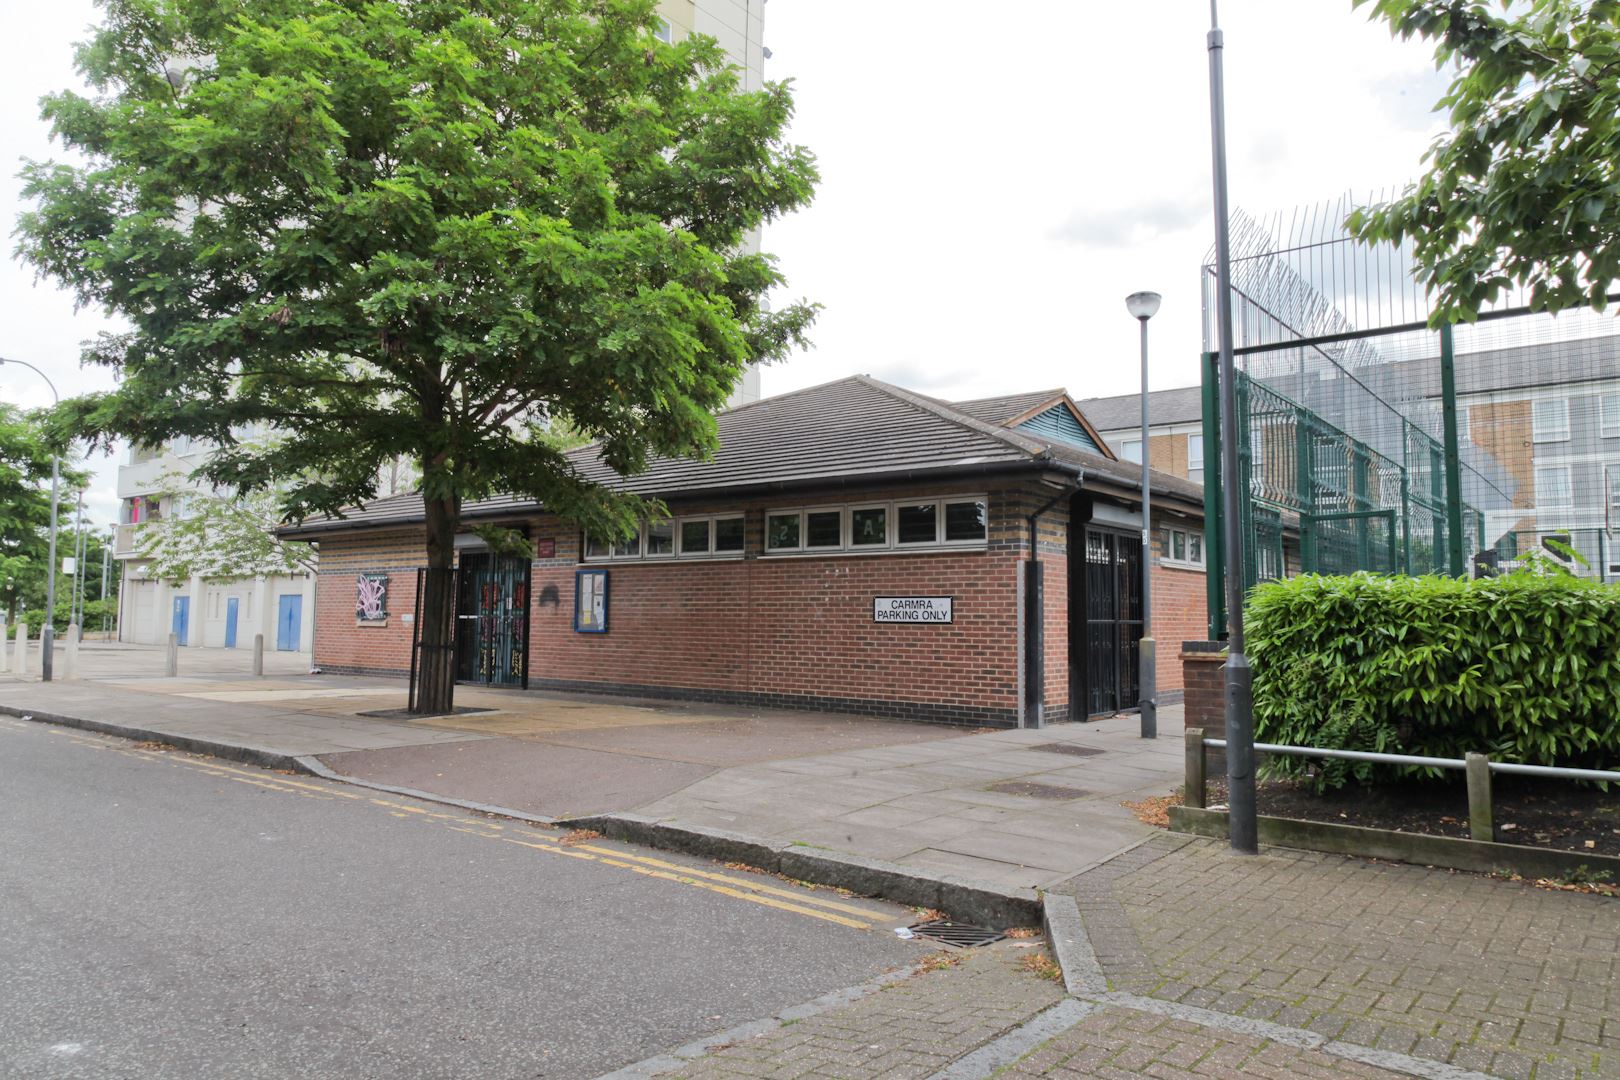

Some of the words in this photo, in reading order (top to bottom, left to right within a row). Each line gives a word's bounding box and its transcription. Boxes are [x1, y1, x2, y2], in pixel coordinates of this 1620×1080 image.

[891, 600, 933, 609] CARMRA
[877, 610, 919, 620] PARKING
[921, 610, 947, 620] ONLY
